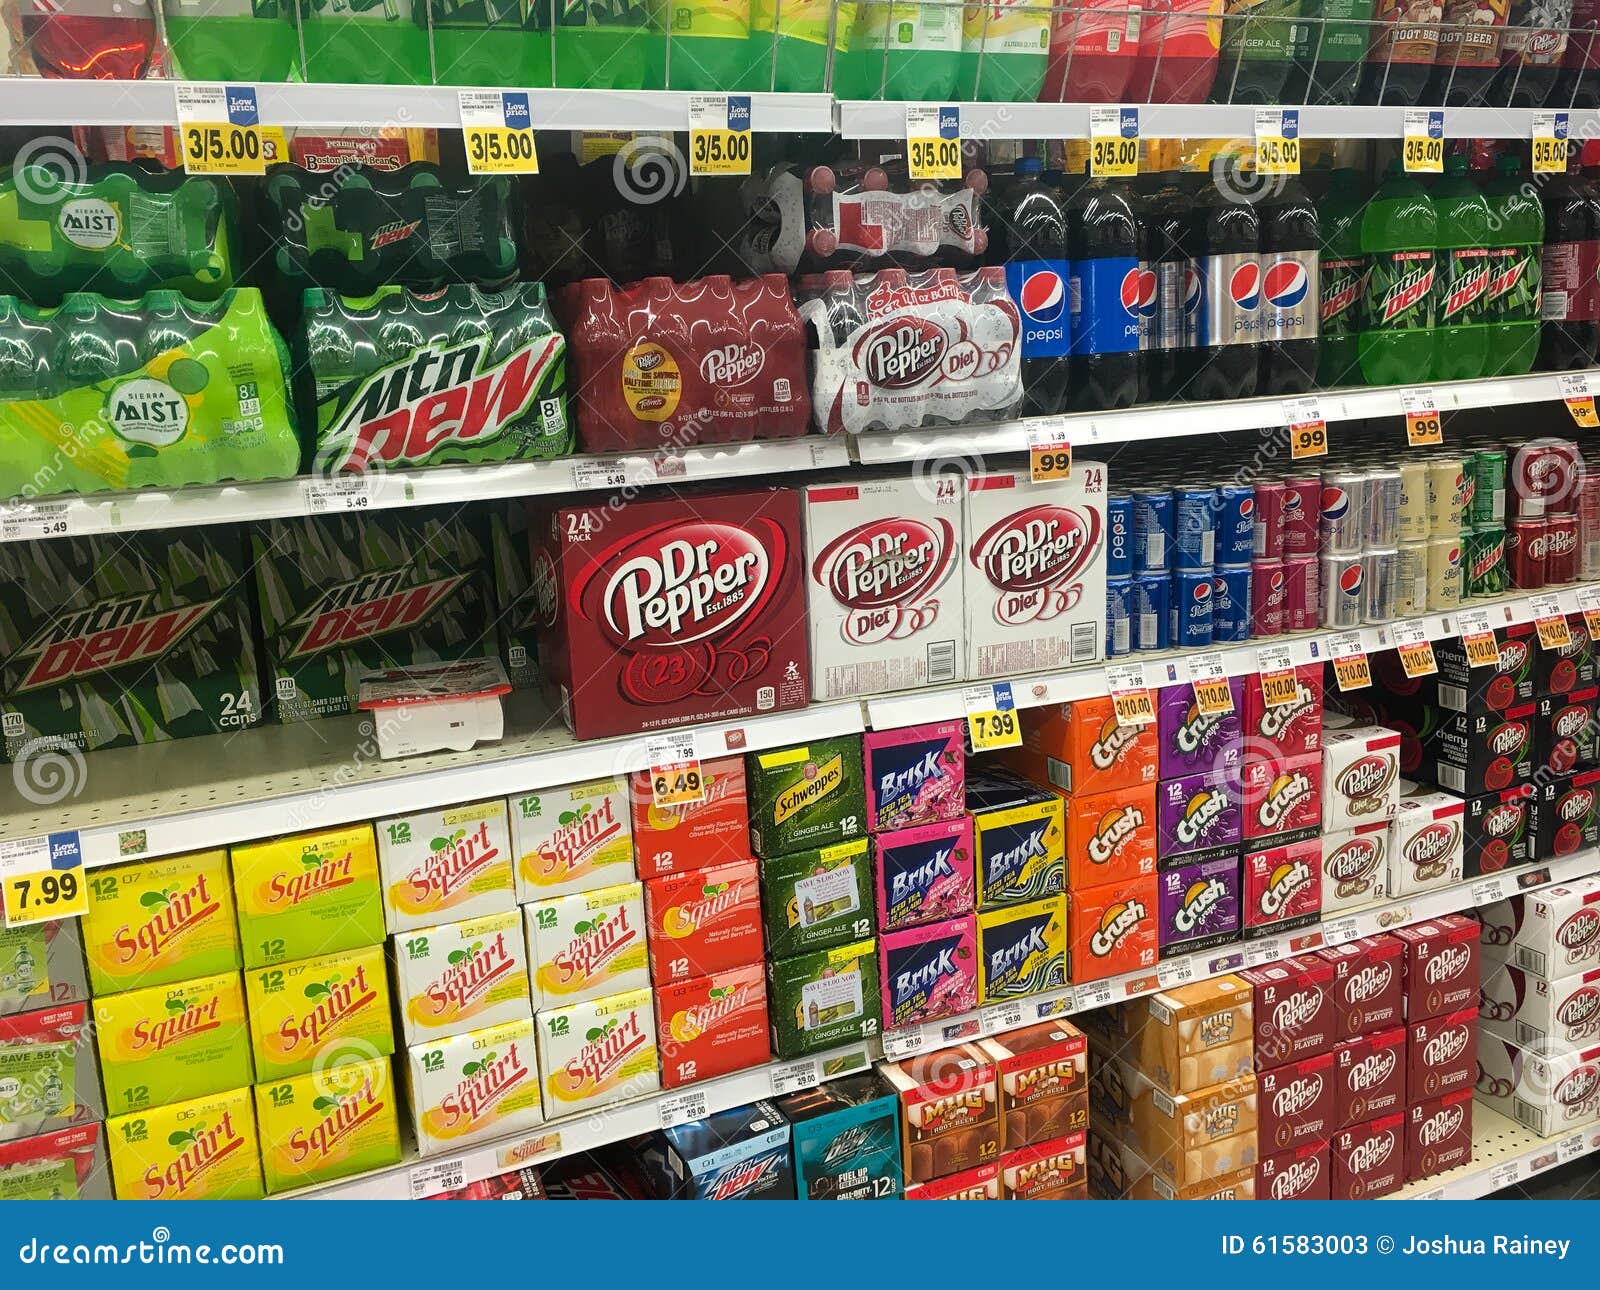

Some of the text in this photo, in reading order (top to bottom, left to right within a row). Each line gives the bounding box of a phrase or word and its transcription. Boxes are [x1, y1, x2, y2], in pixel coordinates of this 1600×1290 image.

[1392, 30, 1421, 40] ROOT
[1465, 33, 1493, 44] BEER
[230, 104, 256, 113] price
[231, 97, 252, 106] Low
[507, 103, 525, 112] Low
[505, 108, 528, 117] price
[188, 129, 259, 161] 3/5.00
[471, 133, 532, 160] 3/5.00
[695, 135, 748, 162] 3/5.00
[1094, 142, 1136, 165] 3/5.00
[1260, 142, 1297, 164] 3/5.00
[1406, 141, 1441, 162] 3/5.00
[1535, 143, 1565, 163] 3/5.00
[305, 155, 340, 170] Boston
[912, 142, 958, 167] 3/5.00
[63, 215, 115, 231] MIST
[870, 282, 890, 310] 8
[1268, 314, 1304, 330] pepsi
[897, 327, 923, 347] Dr
[1027, 328, 1063, 343] pepsi
[725, 344, 746, 360] Dr
[869, 334, 941, 382] Pepper
[950, 351, 974, 370] Diet
[709, 349, 760, 383] Pepper
[240, 385, 248, 399] 8
[776, 381, 788, 391] 150
[115, 401, 180, 422] MIST
[543, 402, 555, 418] 8
[1051, 432, 1065, 441] 1.39
[1411, 420, 1439, 437] .99
[1295, 430, 1325, 449] .99
[1034, 453, 1069, 473] .99
[607, 475, 625, 484] 5.49
[1085, 469, 1102, 486] 24
[936, 480, 955, 498] 24
[346, 497, 368, 508] 5.49
[43, 522, 67, 534] 5.49
[567, 513, 591, 534] 24
[568, 533, 591, 542] PACK
[1024, 519, 1059, 550] Dr
[1112, 510, 1126, 559] pepsi
[998, 526, 1080, 584] Pepper
[660, 540, 718, 590] Dr
[846, 540, 932, 601] Pepper
[303, 572, 402, 619] Mtn
[607, 552, 757, 640] Pepper
[706, 590, 744, 615] Est.1885
[1008, 591, 1038, 617] Diet
[31, 600, 142, 650] Mtn
[858, 609, 890, 636] Diet
[1278, 658, 1290, 667] 3.99
[1403, 648, 1433, 666] 3/10.00
[653, 653, 685, 685] 23
[1209, 666, 1222, 674] 3.99
[1337, 660, 1368, 679] 3/10.00
[278, 680, 294, 689] 170
[1129, 677, 1143, 686] 3.99
[1264, 681, 1296, 699] 3/10.00
[759, 689, 772, 699] 150
[1197, 687, 1230, 705] 3/10.00
[220, 691, 252, 716] 24
[1116, 697, 1150, 716] 3/10.00
[5, 715, 22, 726] 170
[220, 713, 256, 726] cans
[975, 714, 1014, 740] 7.99
[1436, 728, 1468, 747] cherry
[677, 749, 693, 759] 7.99
[1358, 763, 1376, 780] Dr
[655, 772, 699, 796] 6.49
[780, 766, 840, 816] Schweppes
[1168, 783, 1182, 796] 12
[519, 796, 541, 814] 12
[880, 793, 910, 815] ICED TEA
[1260, 773, 1309, 828] Crush
[523, 810, 541, 818] PACK
[1178, 790, 1227, 844] Crush
[1277, 792, 1311, 831] Strawberry
[387, 822, 411, 840] 12
[793, 822, 834, 837] GINGER ALE
[839, 815, 857, 830] 12
[1201, 814, 1220, 837] Grape
[391, 837, 411, 845] PACK
[537, 797, 615, 874] Squirt
[52, 847, 78, 859] price
[54, 843, 76, 851] Low
[409, 822, 491, 902] Squirt
[425, 846, 451, 870] Diet
[653, 852, 673, 867] 12
[656, 863, 673, 872] PACK
[90, 877, 118, 895] 12
[268, 852, 353, 904] Squirt
[14, 873, 78, 909] 7.99
[95, 893, 119, 901] PACK
[114, 874, 211, 963] Squirt
[1091, 901, 1145, 956] Crush
[1116, 923, 1139, 949] Orange
[260, 939, 285, 956] 12
[805, 982, 822, 992] SAVE
[841, 973, 856, 982] NOW
[1444, 990, 1470, 1003] PLAYOFF
[1277, 996, 1321, 1031] Pepper
[815, 1025, 854, 1040] GINGER ALE
[1294, 1037, 1323, 1050] PLAYOFF
[1, 1051, 30, 1063] SAVE
[440, 1043, 521, 1127] Squirt
[798, 1075, 815, 1085] 2/9.00
[1018, 1061, 1073, 1092] MUG
[124, 1086, 149, 1102] 12
[269, 1084, 293, 1101] 12
[1047, 1086, 1065, 1096] BEER
[687, 1106, 705, 1117] 2/9.00
[924, 1090, 982, 1123] MUG
[934, 1117, 974, 1133] ROOT BEER
[1070, 1110, 1085, 1123] 12
[1294, 1123, 1323, 1136] PLAYOFF
[143, 1111, 235, 1200] Squirt
[979, 1141, 996, 1156] 12
[442, 1176, 463, 1188] 2/9.00
[839, 1168, 867, 1183] FUEL UP
[872, 1177, 890, 1197] 12
